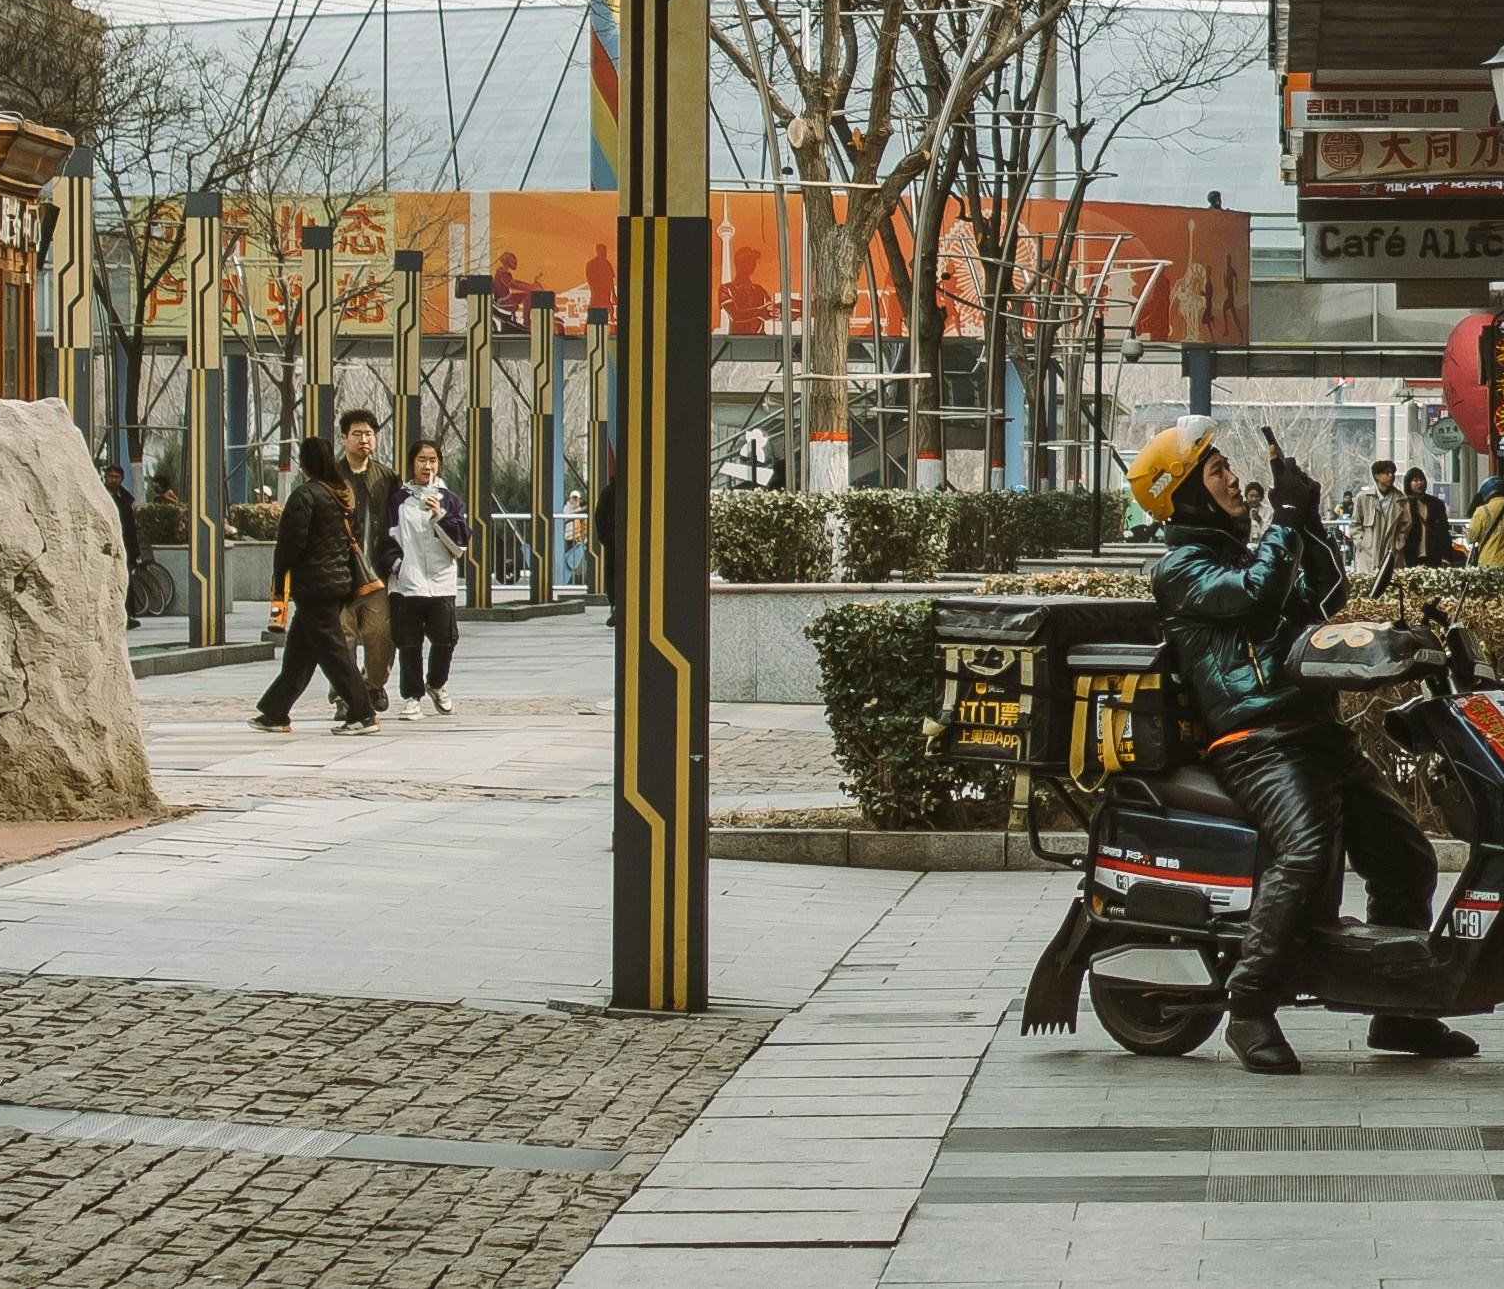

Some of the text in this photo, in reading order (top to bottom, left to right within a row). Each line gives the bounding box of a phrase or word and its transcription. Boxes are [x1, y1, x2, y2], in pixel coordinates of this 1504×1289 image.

[1319, 226, 1407, 259] Café
[959, 701, 1019, 725] 订门票
